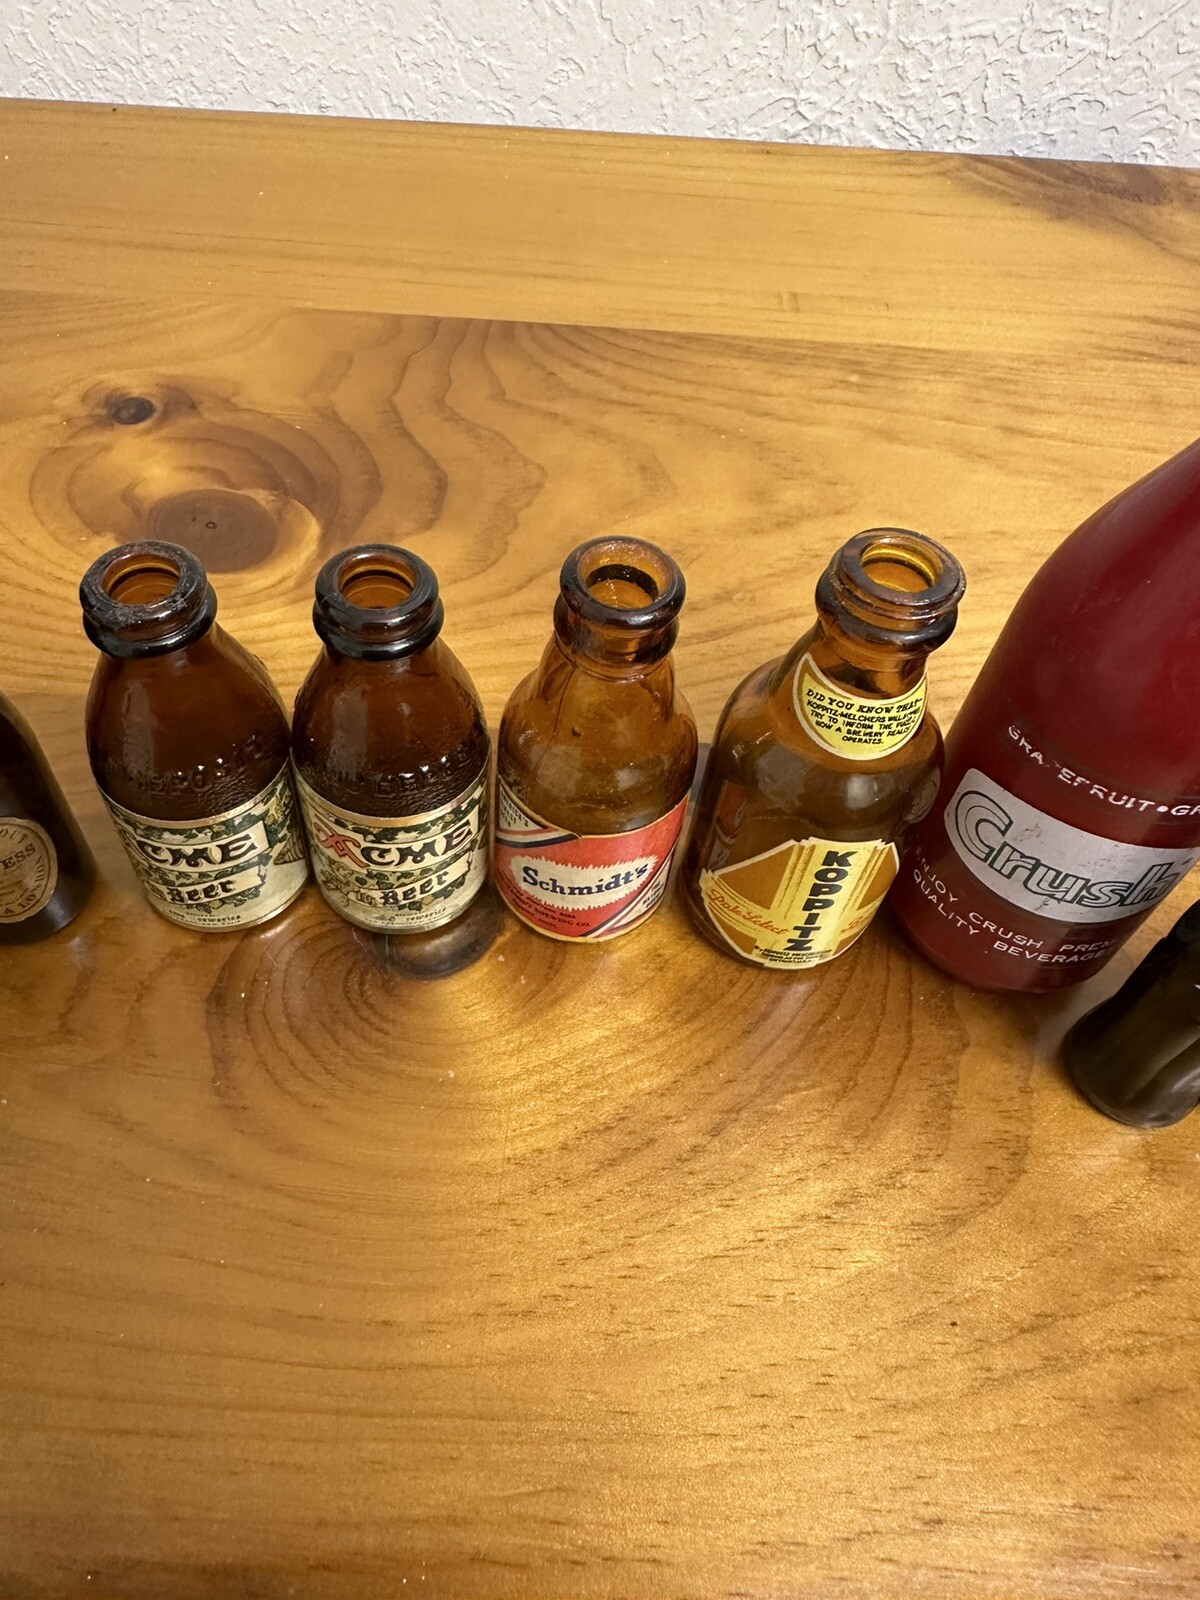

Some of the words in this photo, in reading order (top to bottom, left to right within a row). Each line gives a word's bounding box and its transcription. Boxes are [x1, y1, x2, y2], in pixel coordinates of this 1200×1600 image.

[806, 688, 826, 702] DID
[828, 696, 855, 710] YOU
[857, 704, 894, 714] KNOW
[896, 698, 922, 713] THAT
[810, 709, 825, 720] TRY
[828, 715, 838, 724] TO
[842, 719, 874, 730] INFORM
[879, 722, 893, 730] THE
[815, 719, 833, 729] HOW
[846, 728, 884, 738] BREWERY
[841, 735, 884, 744] OPERATES.
[1008, 725, 1155, 812] GRAEFRUIT
[313, 813, 473, 868] ACME
[955, 790, 1181, 909] Crush
[379, 868, 439, 906] Beer
[522, 863, 648, 896] Schmidt's
[783, 850, 858, 951] KOPPITZ
[913, 869, 980, 935] QUALITY
[916, 846, 959, 902] NJOY
[969, 911, 1044, 949] CRUSH
